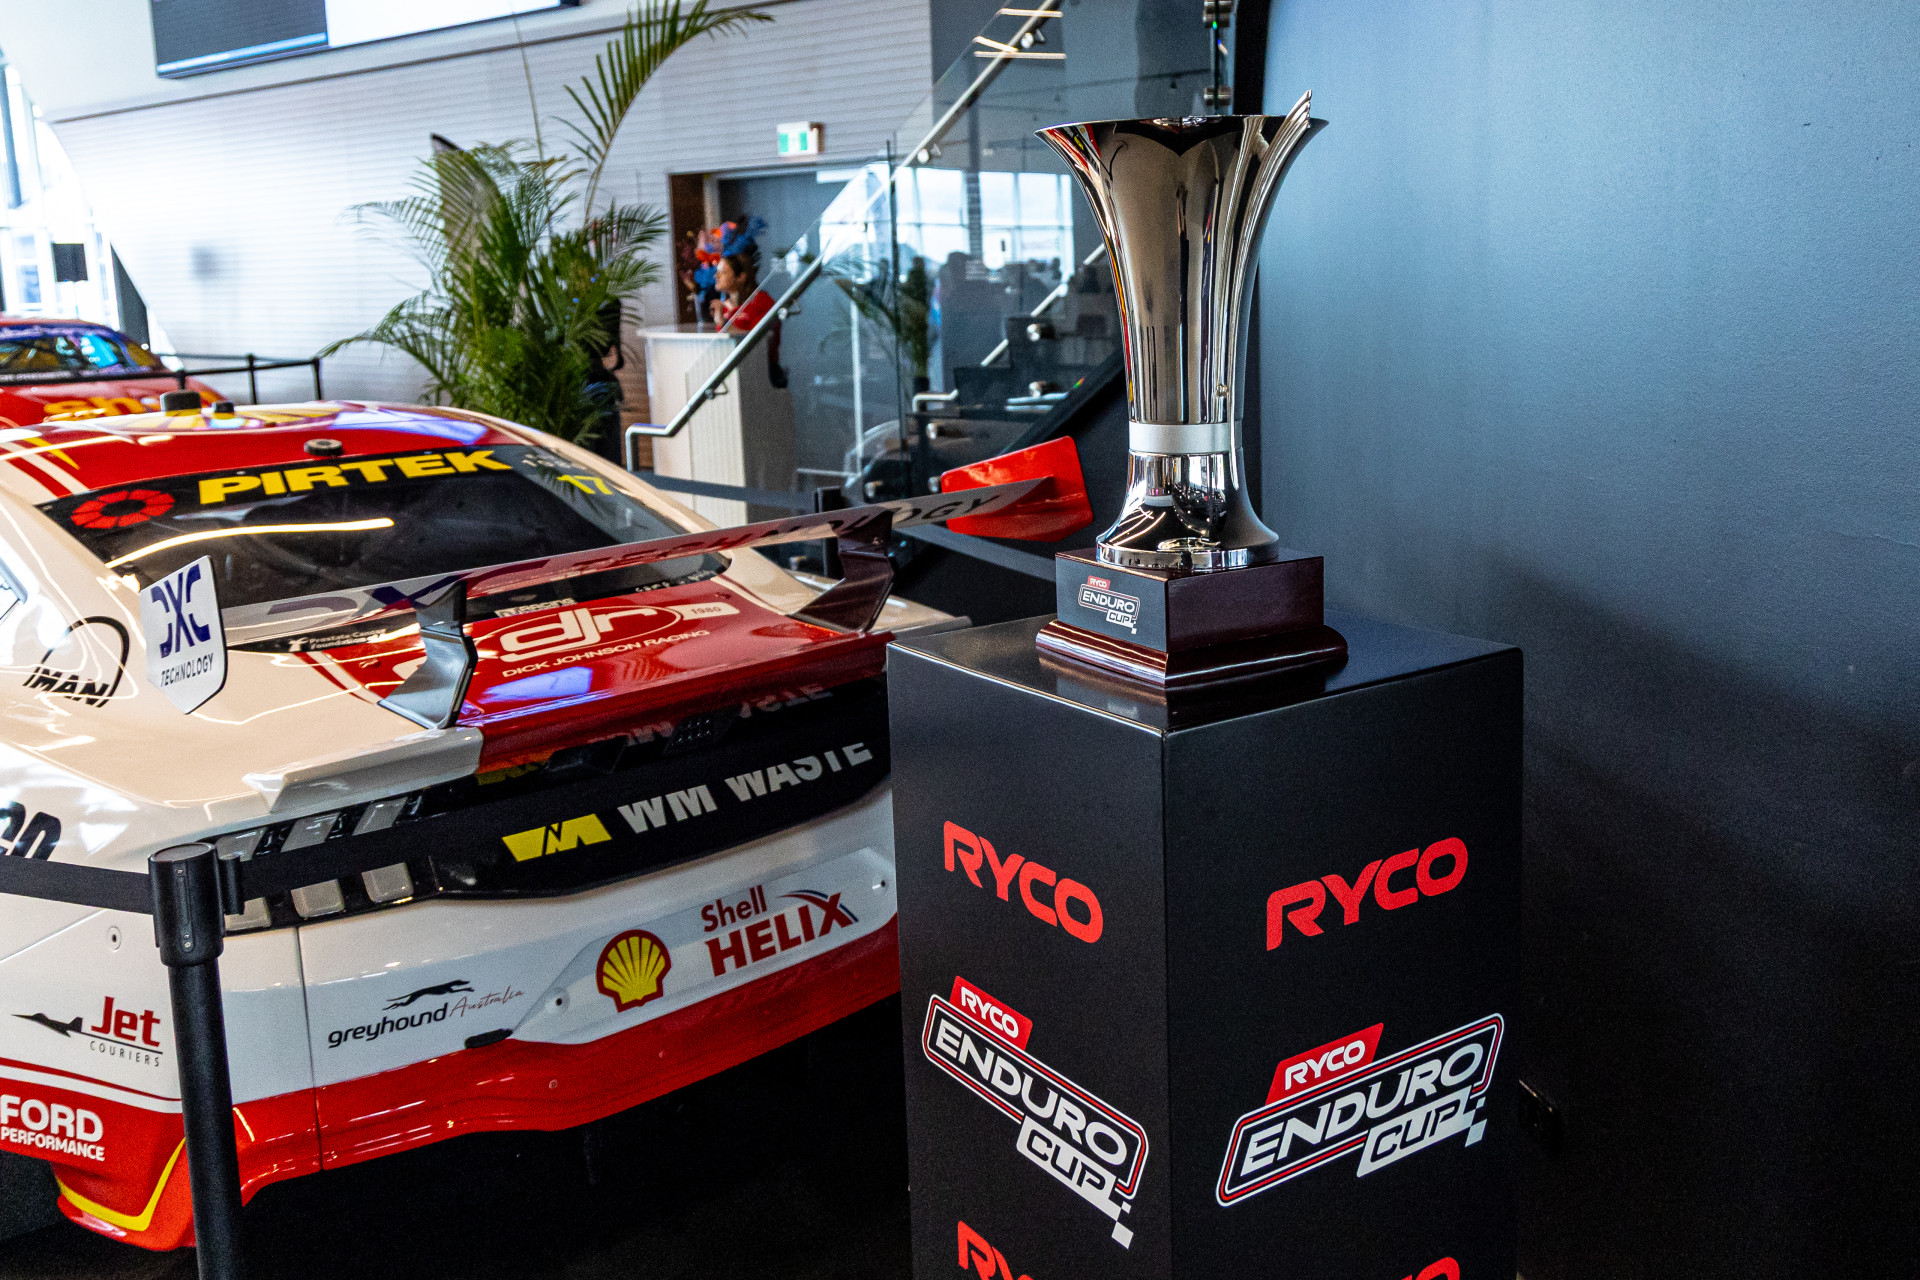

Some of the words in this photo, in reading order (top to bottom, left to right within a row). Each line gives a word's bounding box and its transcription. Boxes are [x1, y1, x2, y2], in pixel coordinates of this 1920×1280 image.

[198, 450, 513, 505] PIRTEK
[556, 474, 613, 495] 17
[1082, 591, 1135, 613] ENDURO
[1088, 577, 1108, 589] RYCO
[150, 563, 211, 659] DXC
[1108, 612, 1131, 624] CUP
[160, 652, 214, 688] TECHNOLOGY
[502, 661, 549, 678] DICK
[552, 642, 642, 667] JOHNSON
[644, 630, 711, 648] RACING
[617, 784, 718, 835] WM
[724, 742, 874, 802] WASTE
[944, 820, 1104, 944] RYCO
[1266, 837, 1469, 951] RYCO
[701, 885, 767, 933] Shell
[705, 892, 854, 977] HELIX
[91, 996, 161, 1047] Jet
[328, 1002, 449, 1048] greyhound
[449, 985, 524, 1017] Australia
[960, 986, 1019, 1039] RYCO
[90, 1040, 160, 1067] COURIERS
[1285, 1040, 1366, 1091] RYCO
[935, 1018, 1128, 1166] ENDURO
[1240, 1043, 1484, 1177] ENDURO
[0, 1094, 104, 1143] FORD
[0, 1126, 105, 1162] PERFORMANCE
[1370, 1098, 1464, 1163] CUP
[1026, 1128, 1106, 1191] CUP
